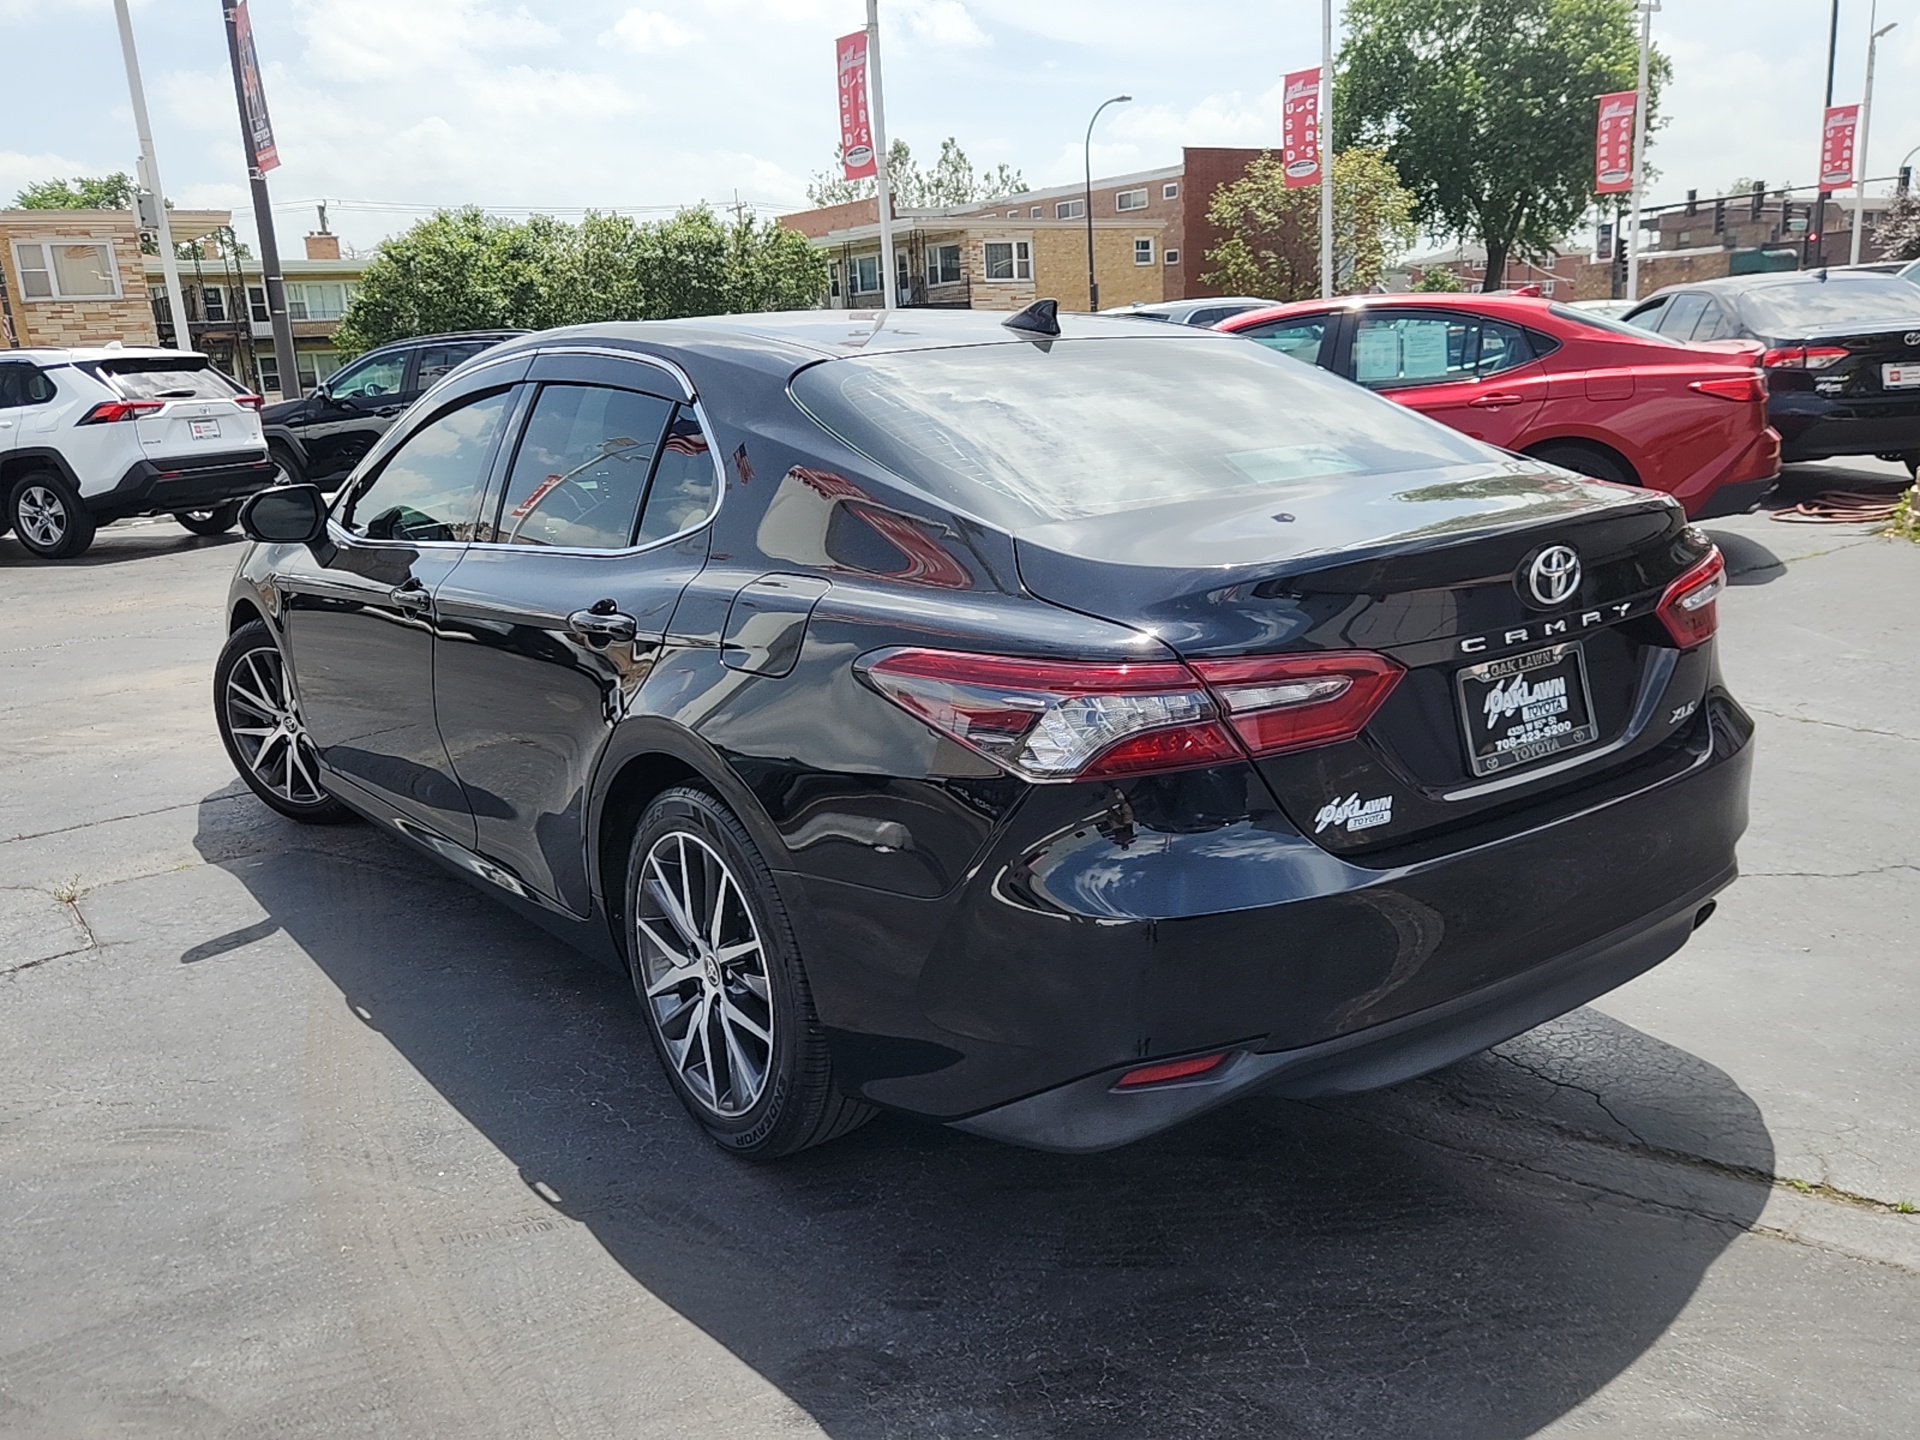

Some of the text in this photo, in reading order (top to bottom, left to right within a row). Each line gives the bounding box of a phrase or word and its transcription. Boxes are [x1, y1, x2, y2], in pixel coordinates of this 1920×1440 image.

[841, 75, 853, 147] USED
[857, 69, 868, 142] CARS
[1285, 103, 1295, 161] USED
[1305, 98, 1315, 158] CARS
[1600, 120, 1611, 170] USED
[1618, 117, 1629, 168] CARS
[1842, 126, 1853, 170] CARS
[1823, 129, 1834, 172] USED
[1461, 602, 1631, 653] CAMRY
[1490, 651, 1550, 676] OAK LAWN
[1527, 700, 1562, 717] TOYOTA
[1669, 700, 1696, 724] XLE
[1495, 720, 1571, 752] 708-423-5200
[1512, 738, 1560, 761] TOYOTA
[1353, 812, 1386, 826] TOYOTA
